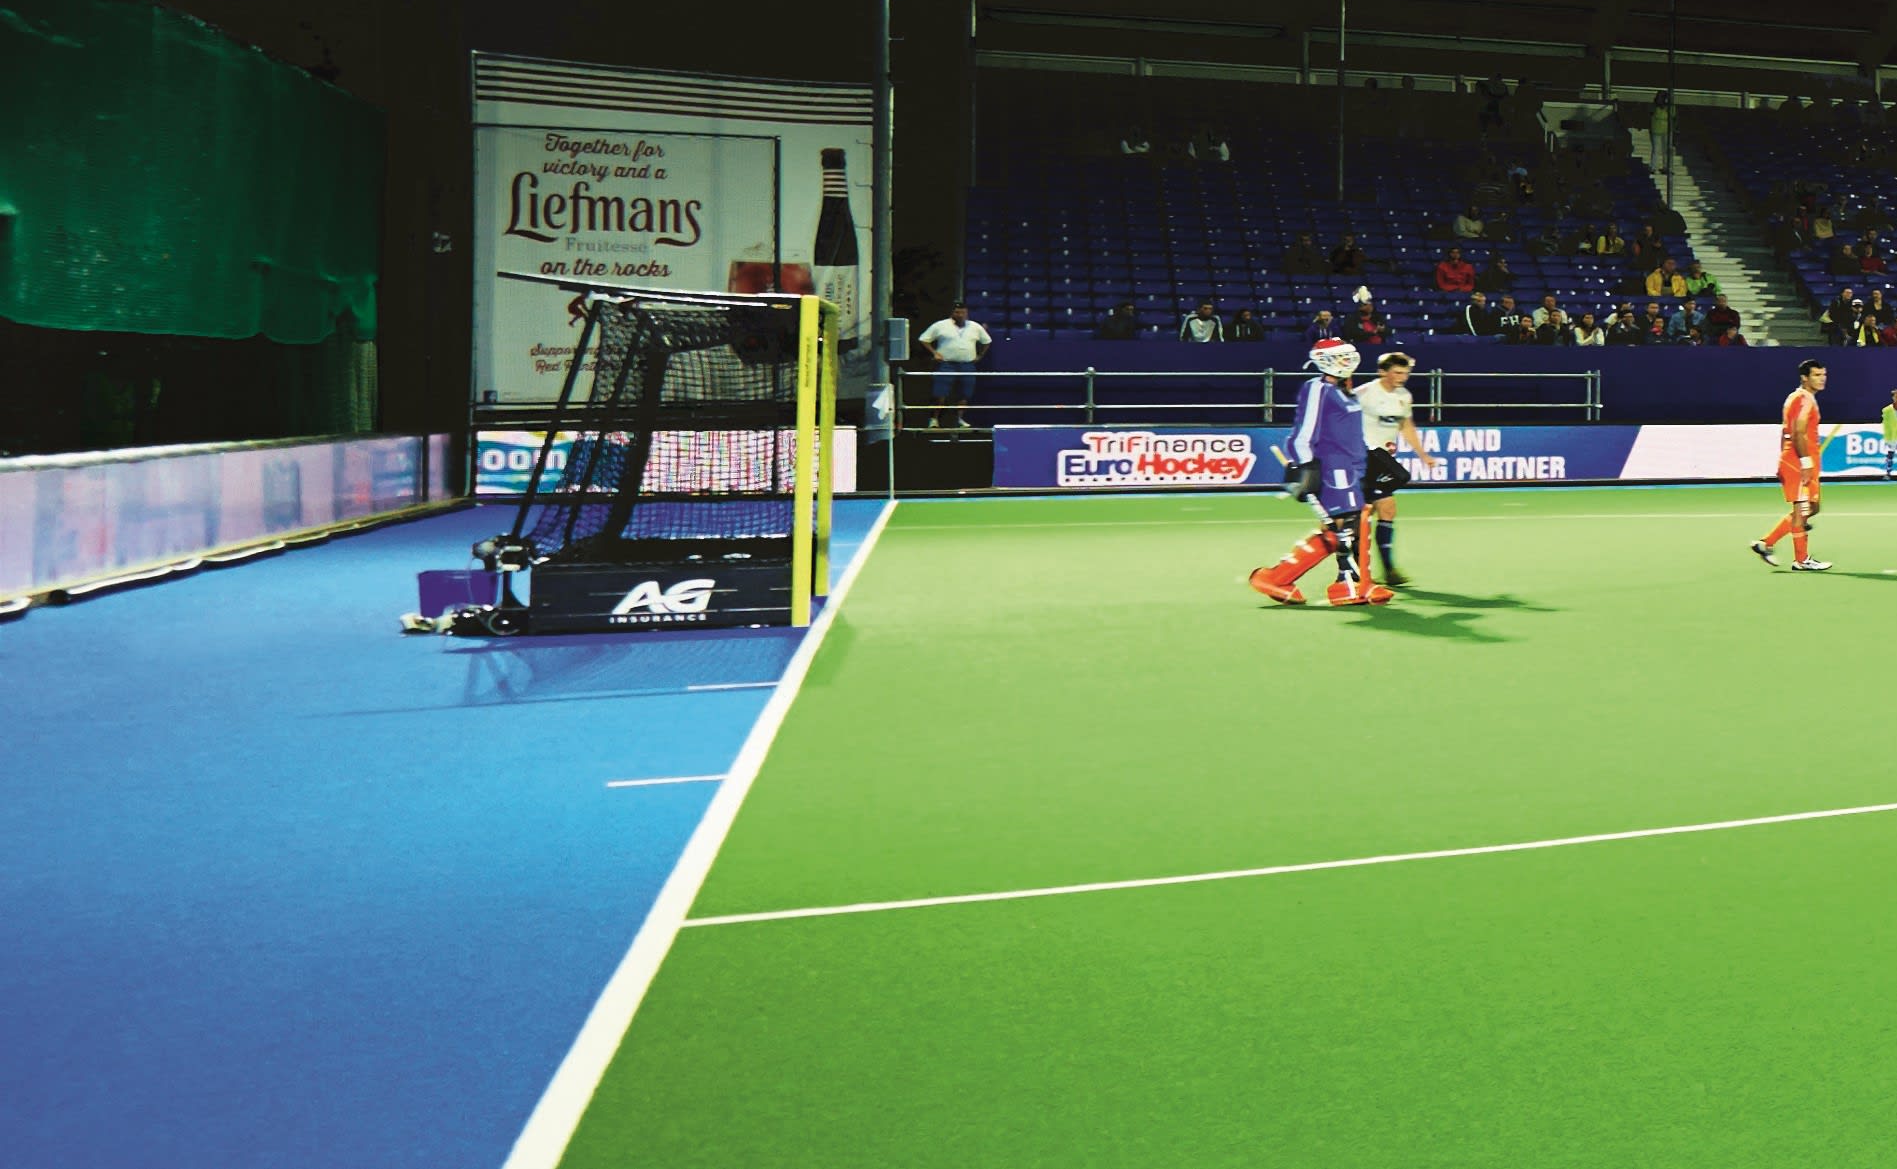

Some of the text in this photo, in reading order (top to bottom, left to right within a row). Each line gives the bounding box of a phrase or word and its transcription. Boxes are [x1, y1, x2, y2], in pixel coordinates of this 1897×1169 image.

[545, 133, 665, 162] Together for
[543, 159, 668, 182] victory and a
[504, 172, 702, 247] Liefmans
[540, 258, 672, 277] on the rocks
[1089, 435, 1246, 454] TriFinance
[1447, 429, 1501, 452] AND
[1065, 452, 1250, 479] Euro Hockey
[1455, 456, 1566, 481] PARTNER
[611, 578, 716, 614] AG
[608, 614, 707, 624] INSURANCE
